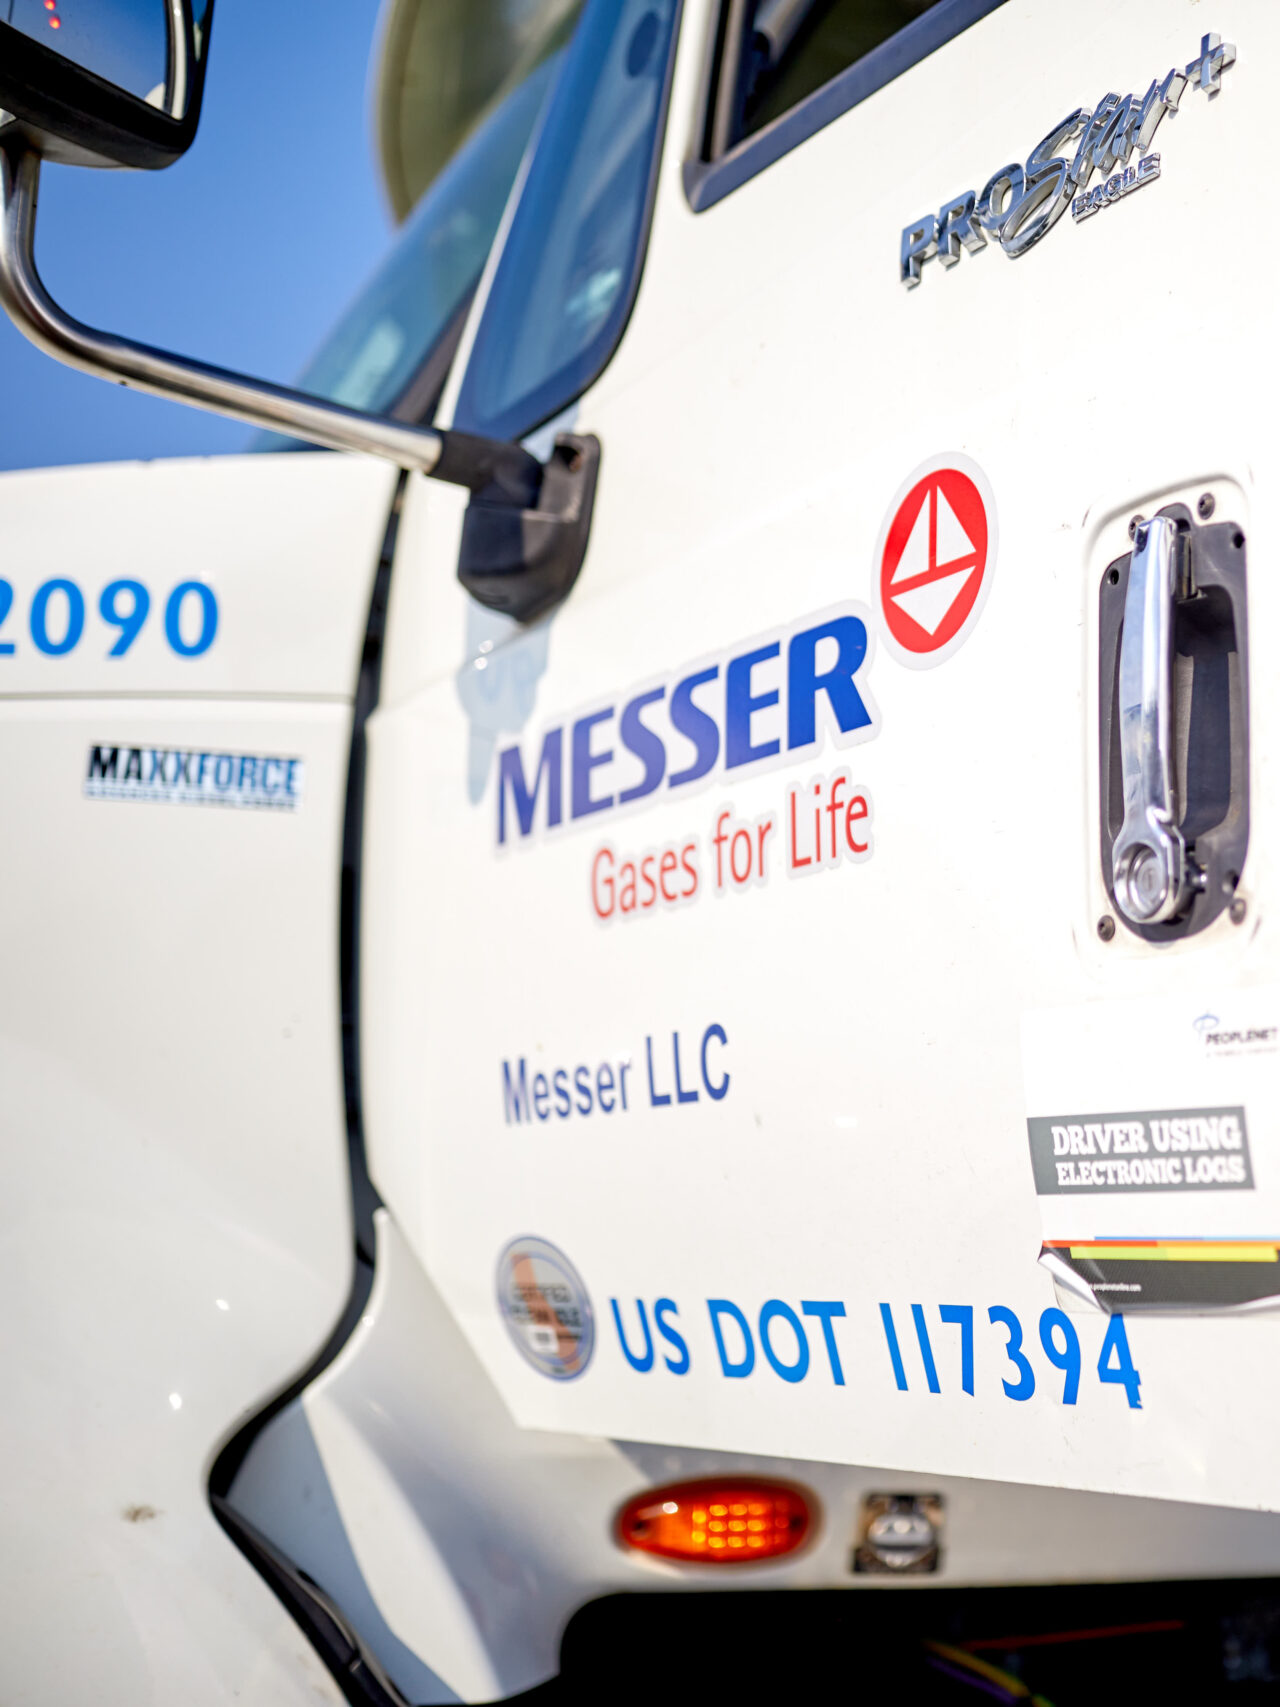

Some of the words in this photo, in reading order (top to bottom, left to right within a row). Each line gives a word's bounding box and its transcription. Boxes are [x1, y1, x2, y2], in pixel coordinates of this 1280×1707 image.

[1071, 153, 1161, 224] EAGLE
[499, 615, 873, 846] MESSER
[88, 744, 300, 798] MAXXFORCE
[591, 843, 698, 920] Gases
[713, 811, 772, 889] for
[791, 776, 869, 869] Life
[1206, 1026, 1278, 1045] PEOPLENET
[502, 1057, 632, 1126] Messer
[646, 1023, 730, 1107] LLC
[1051, 1121, 1149, 1155] DRIVER
[1149, 1115, 1242, 1152] USING
[1055, 1158, 1183, 1186] ELECTRONIC
[1184, 1155, 1247, 1183] LOGS
[610, 1298, 690, 1376] US
[706, 1298, 847, 1386] DOT
[879, 1302, 1143, 1409] 117394
